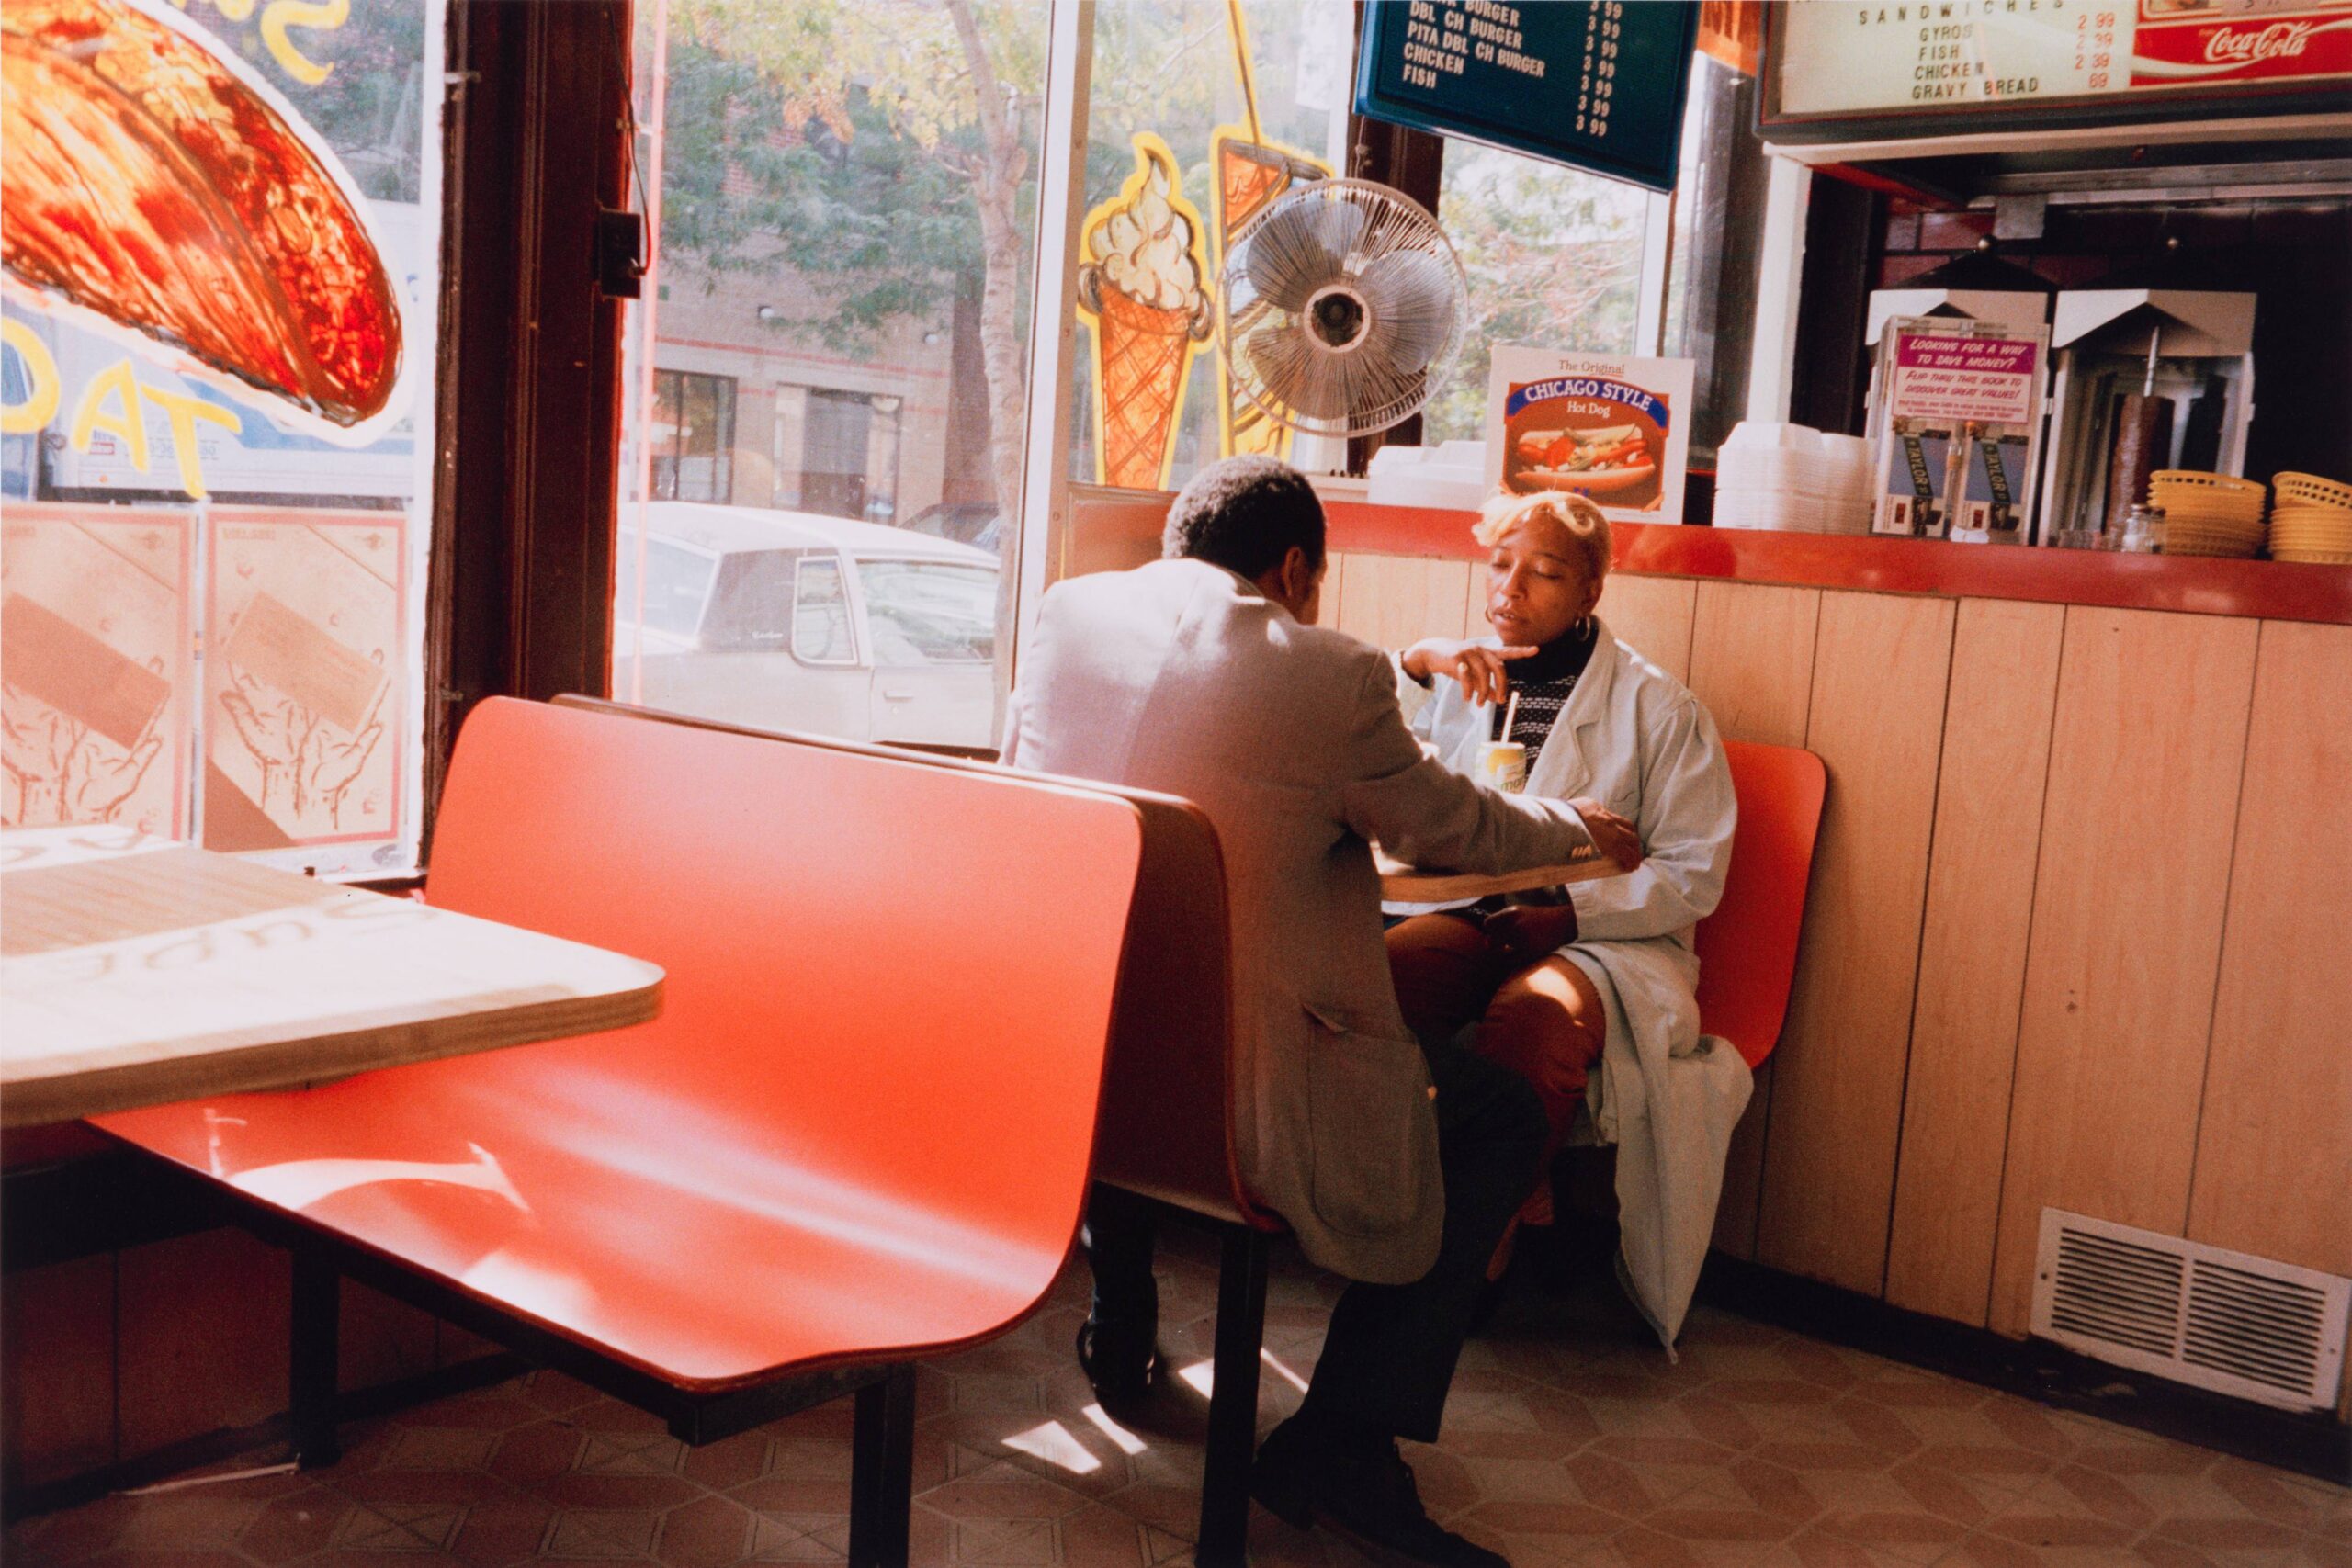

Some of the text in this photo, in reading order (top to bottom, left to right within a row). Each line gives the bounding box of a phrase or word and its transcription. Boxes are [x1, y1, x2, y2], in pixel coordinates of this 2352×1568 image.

[1464, 0, 1520, 27] BURGER
[1605, 1, 1623, 19] 99
[2078, 14, 2087, 30] 2
[1410, 1, 1523, 50] DBL CH BURGER
[1588, 14, 1621, 39] 3 99
[1919, 23, 1972, 42] GYROS
[1403, 42, 1465, 75] CHICKEN
[1407, 20, 1545, 78] PITA DBL CH BURGER
[1585, 34, 1618, 59] 3 99
[1918, 45, 1960, 61] FISH
[1583, 54, 1615, 79] 3 99
[1914, 62, 1984, 81] CHICKEN
[2075, 54, 2084, 70] 2
[1402, 63, 1437, 89] FISH
[1581, 74, 1612, 98] 3 99
[1911, 76, 2039, 100] GRAVY BREAD
[1578, 94, 1610, 118] 3 99
[1576, 114, 1607, 138] 3 99
[1909, 338, 2028, 355] LOOKING FOR A WAY
[1559, 359, 1625, 376] The Original
[1917, 354, 2017, 369] TO SAVE MONEY?
[1905, 370, 1928, 380] FLIP
[2010, 378, 2022, 387] TO
[1525, 379, 1653, 412] CHICAGO STYLE
[1567, 400, 1611, 418] Hot Dog
[1907, 447, 1928, 484] TAYLOR
[1986, 454, 2007, 491] TAYLOR
